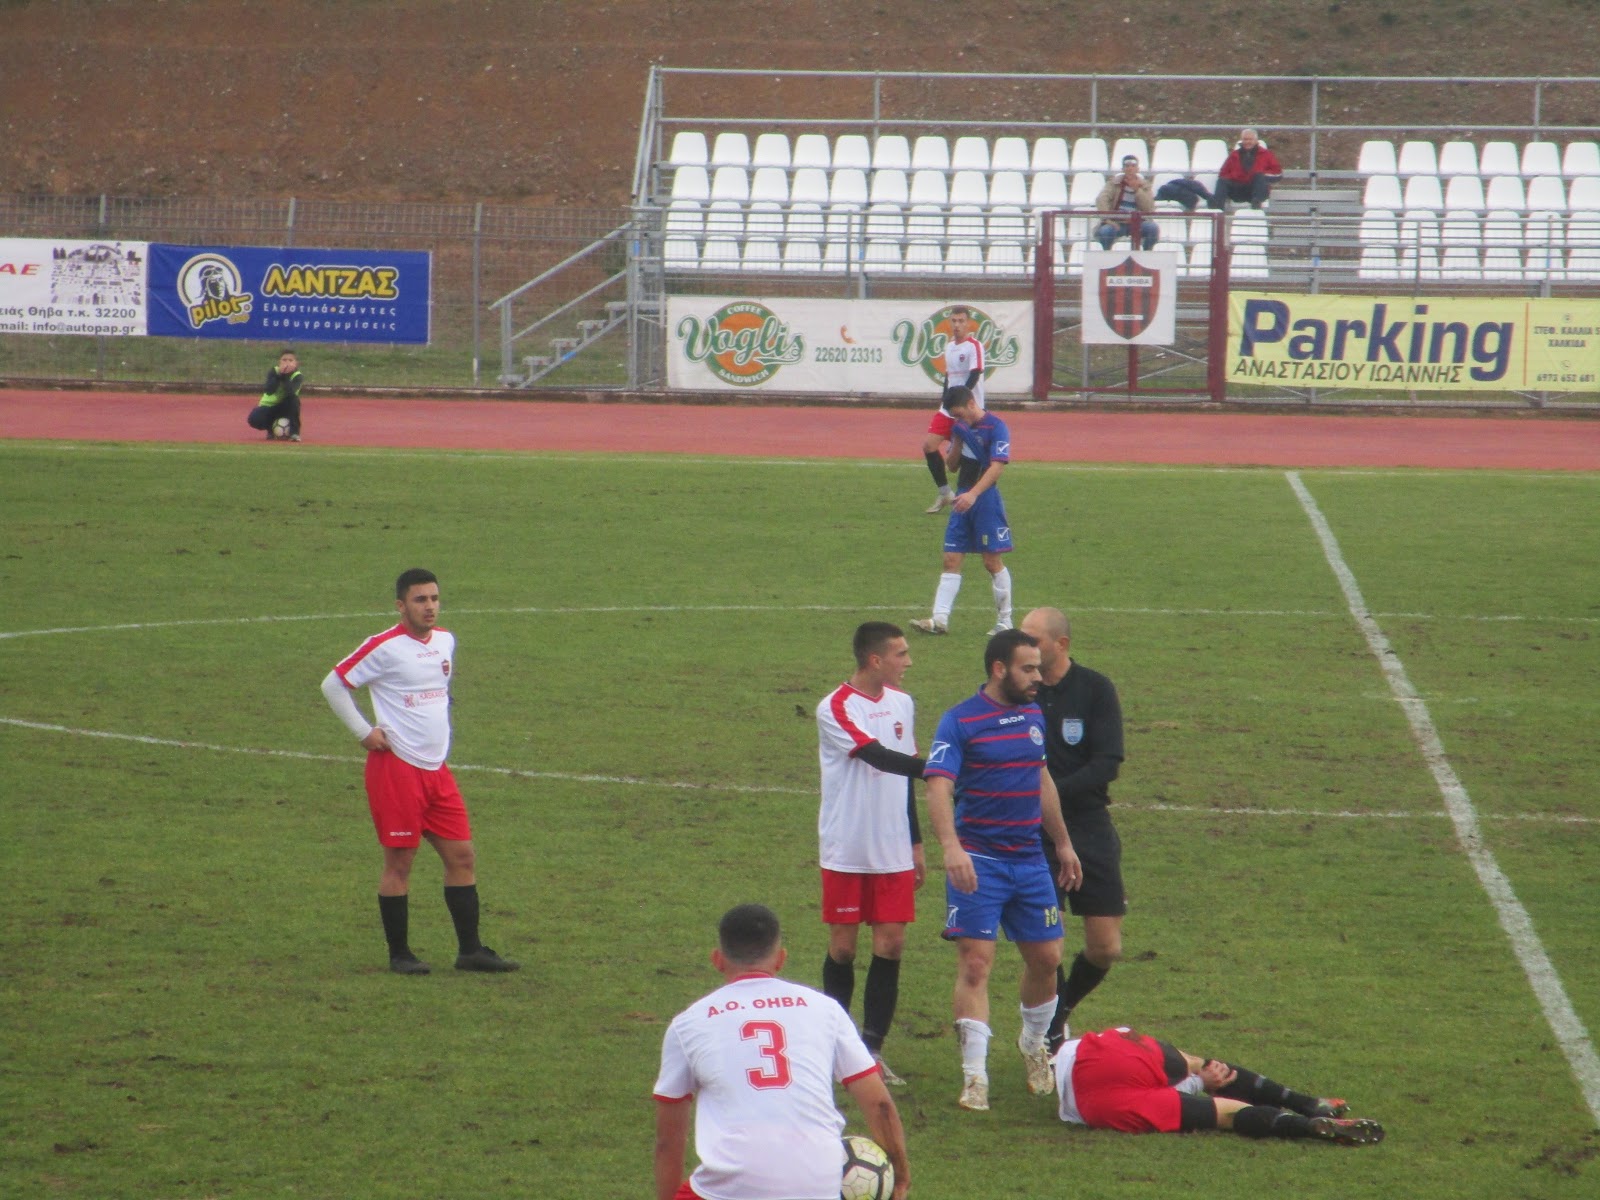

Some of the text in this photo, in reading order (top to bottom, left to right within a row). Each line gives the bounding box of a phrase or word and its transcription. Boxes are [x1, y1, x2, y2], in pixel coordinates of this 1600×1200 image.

[264, 268, 395, 296] ΛΑΝΤΖΑΣ
[28, 306, 63, 318] Θήβα
[95, 308, 136, 318] 32200
[191, 295, 250, 326] pilot
[727, 305, 763, 315] COFFEE
[32, 322, 136, 335] info@autopap.gr
[676, 314, 805, 366] Voglis
[891, 317, 1019, 367] Volis
[1239, 299, 1514, 382] Parking
[815, 346, 883, 363] 22620 23313
[719, 369, 769, 383] SANDWICH
[1233, 358, 1464, 384] ΑΝΑΣΤΑΣΙΟΥ ΙΩΑΝΝΗΣ
[739, 1020, 792, 1091] 3
